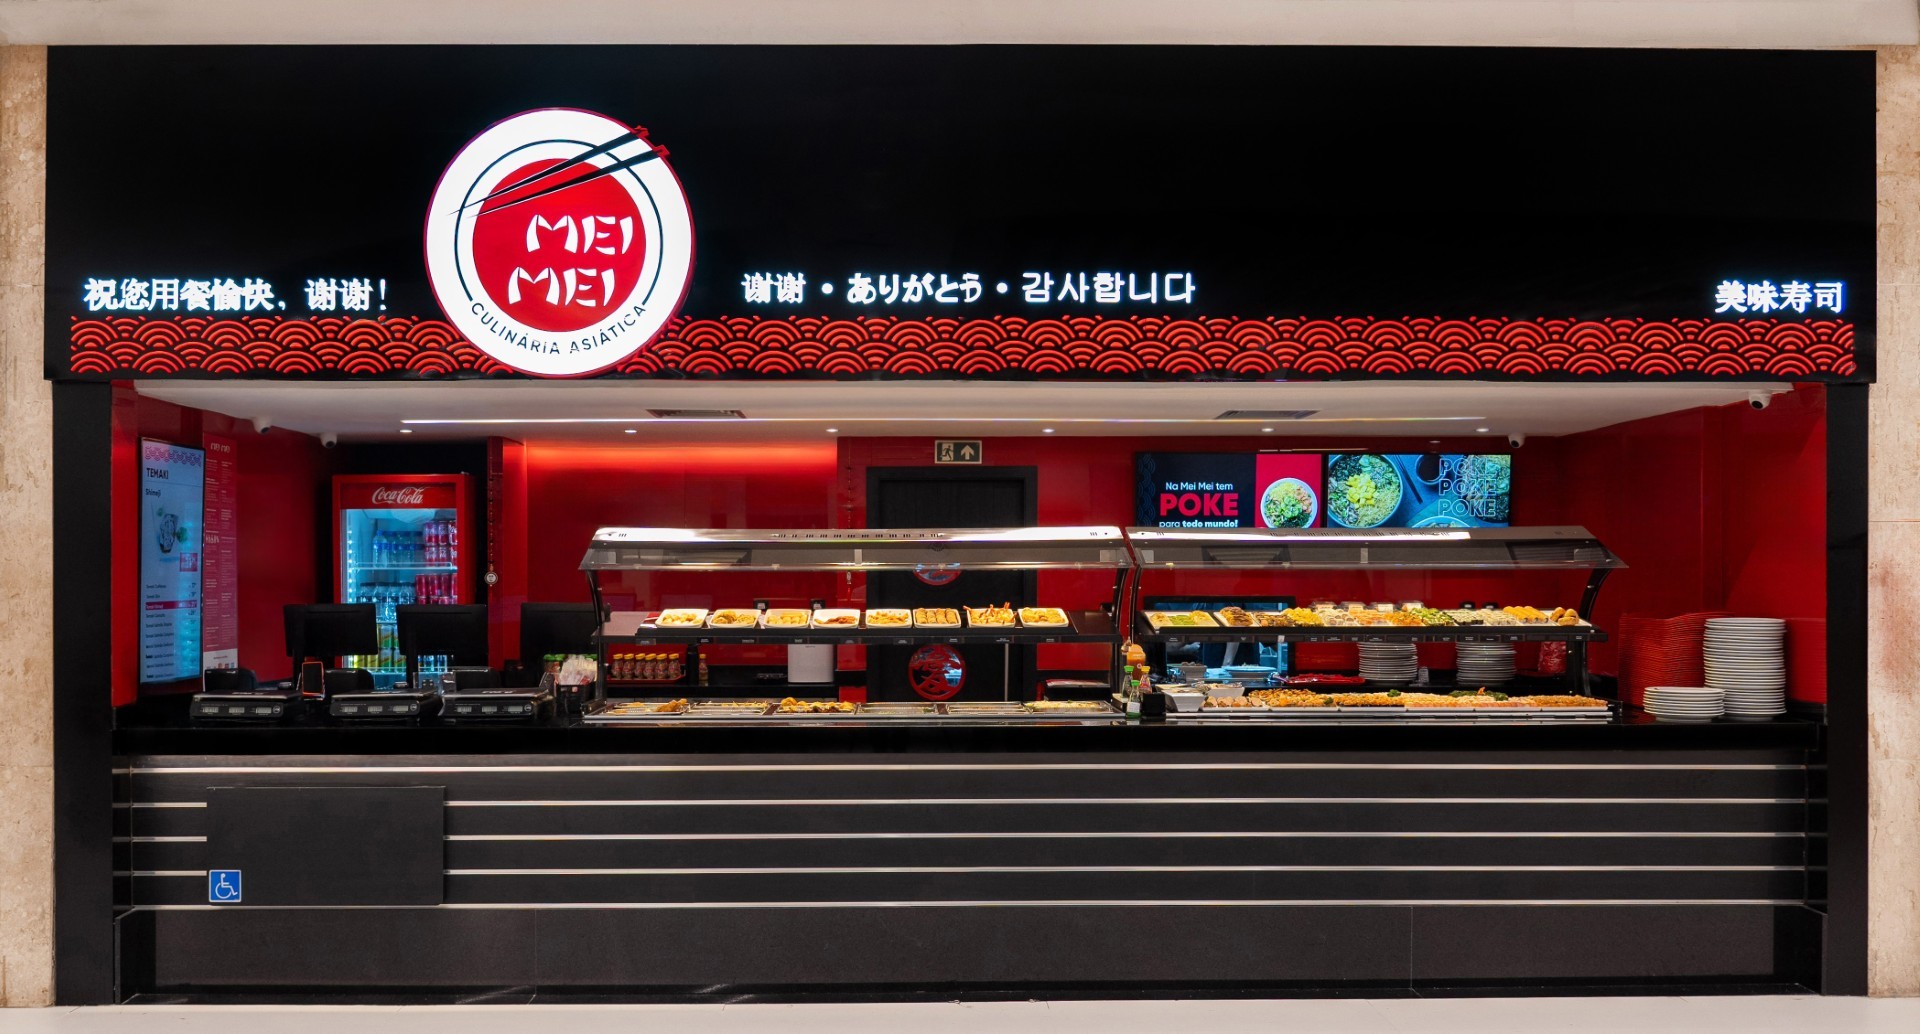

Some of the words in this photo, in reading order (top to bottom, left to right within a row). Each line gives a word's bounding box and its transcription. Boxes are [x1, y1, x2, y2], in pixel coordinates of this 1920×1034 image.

[526, 214, 634, 255] MEI
[507, 266, 616, 307] MEI
[741, 272, 807, 304] 谢谢
[847, 272, 983, 304] ありがとう
[1021, 271, 1197, 304] 감사합니다
[1714, 280, 1843, 313] 美味寿司
[471, 302, 560, 354] CULINÁRIA
[569, 304, 647, 354] ASIÁTICA
[146, 467, 169, 480] TEMAKI
[1165, 482, 1179, 491] Na
[1180, 482, 1197, 491] Mei
[1198, 482, 1214, 491] Mei
[1215, 482, 1234, 491] tem
[1438, 478, 1497, 496] POKE
[372, 486, 425, 504] Coca-Cola
[1160, 493, 1239, 517] POKE
[1438, 498, 1496, 517] POKE
[1159, 520, 1181, 528] para
[1181, 519, 1204, 528] todo
[1204, 519, 1239, 528] mundo!
